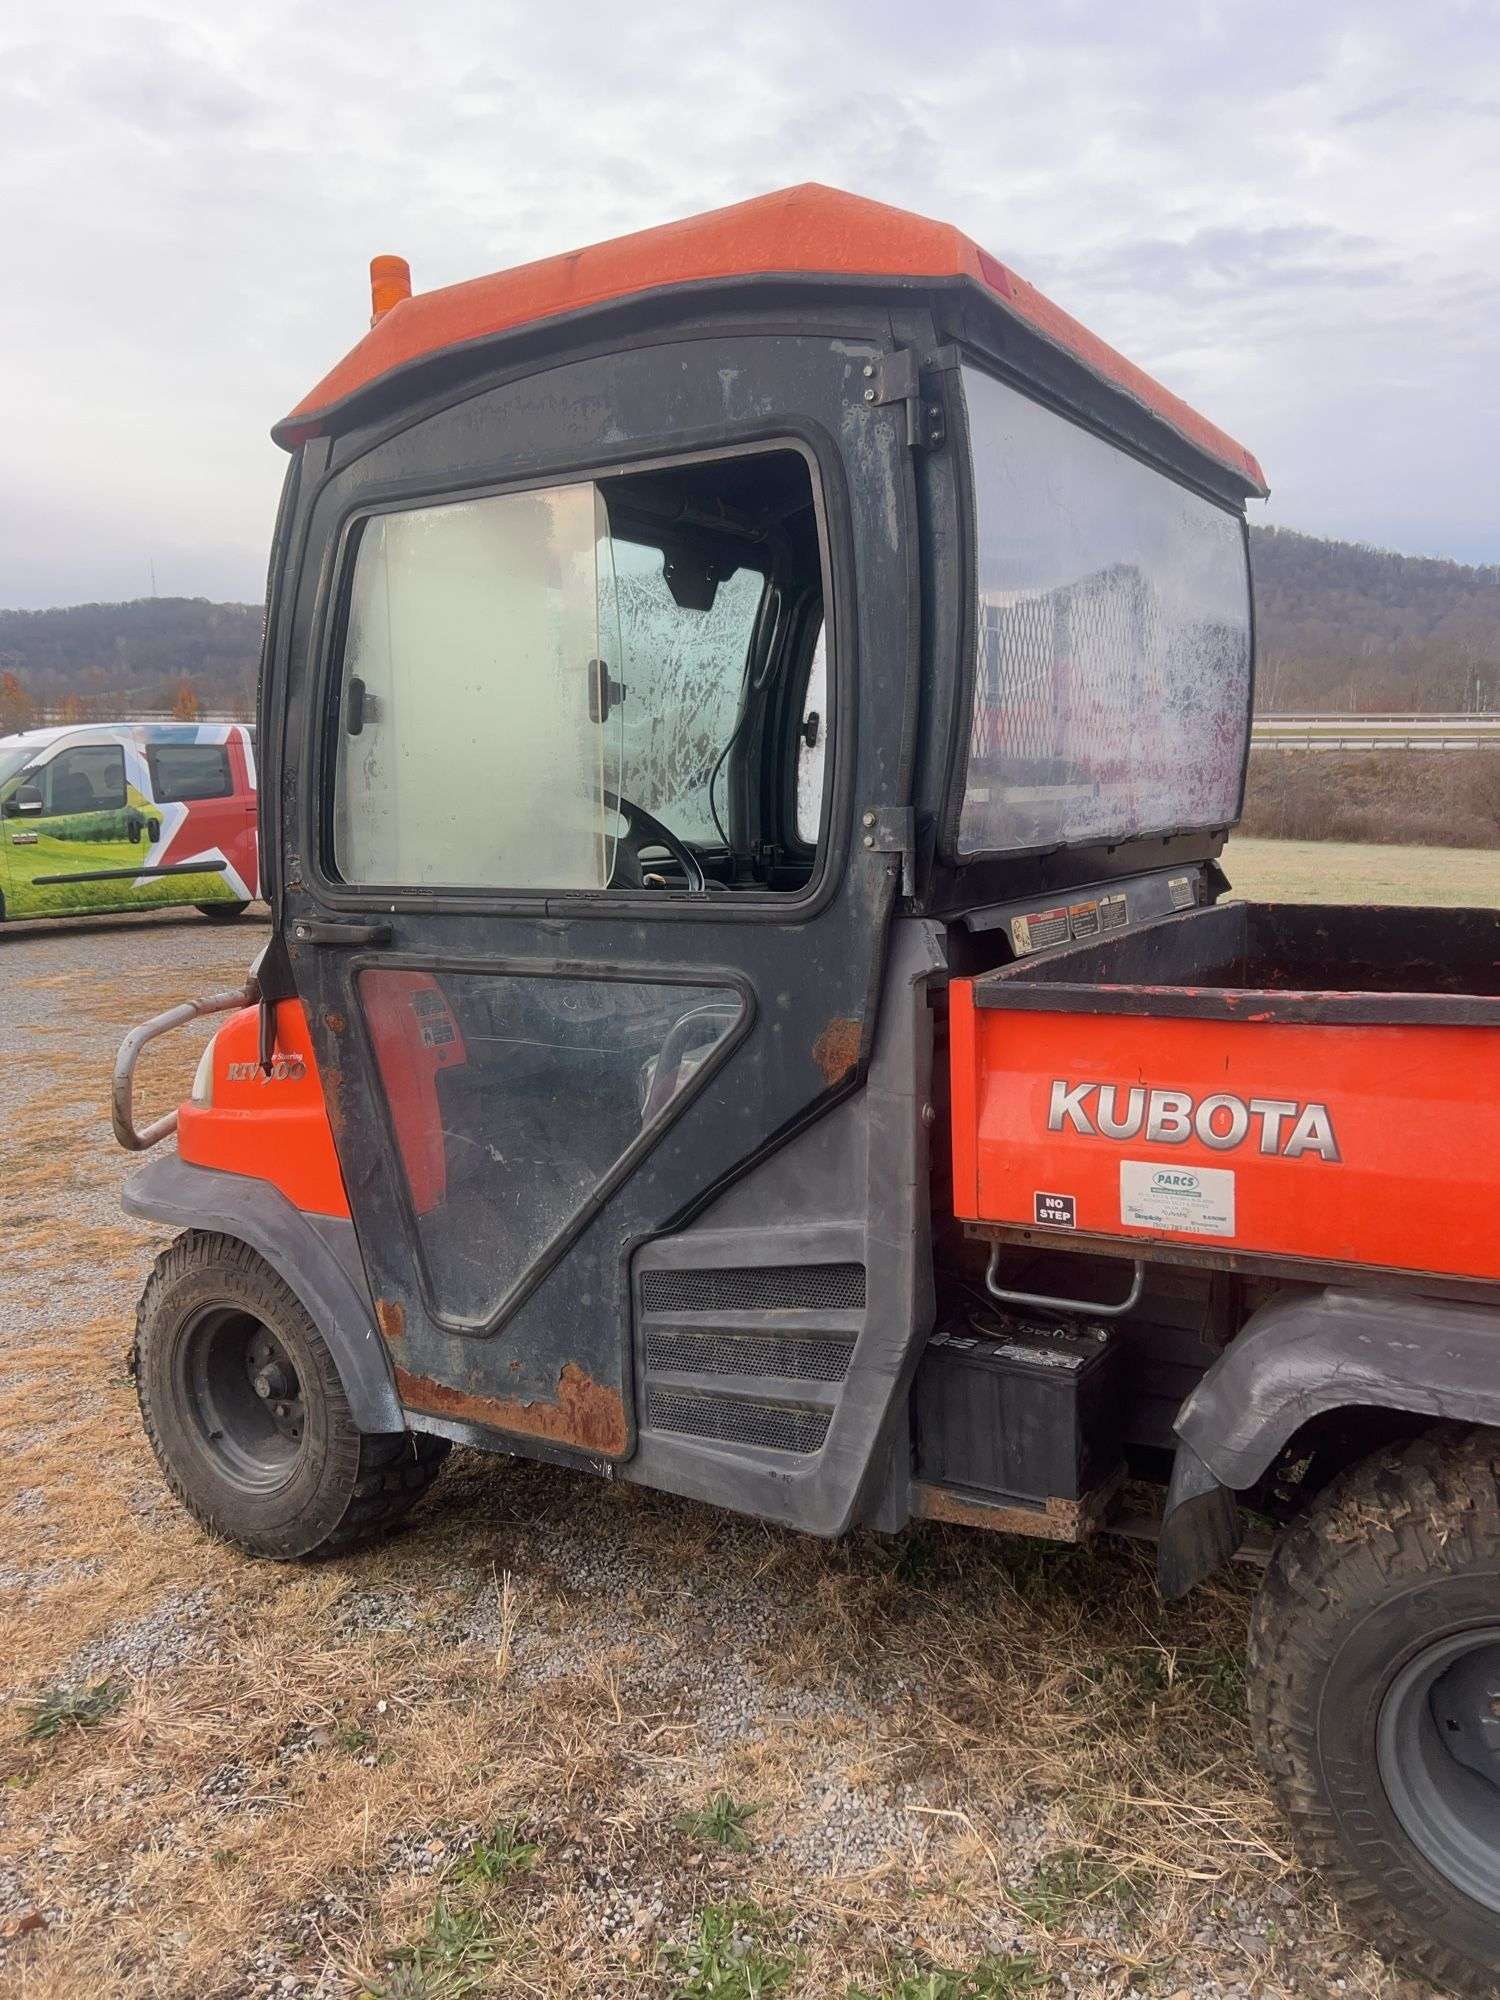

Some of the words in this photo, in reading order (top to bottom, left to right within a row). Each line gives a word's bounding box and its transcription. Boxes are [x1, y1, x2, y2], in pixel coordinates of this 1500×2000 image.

[1048, 1079, 1342, 1163] KUBOTA
[1157, 1174, 1195, 1187] PARCS
[1045, 1197, 1064, 1209] NO
[1039, 1208, 1071, 1221] STEP
